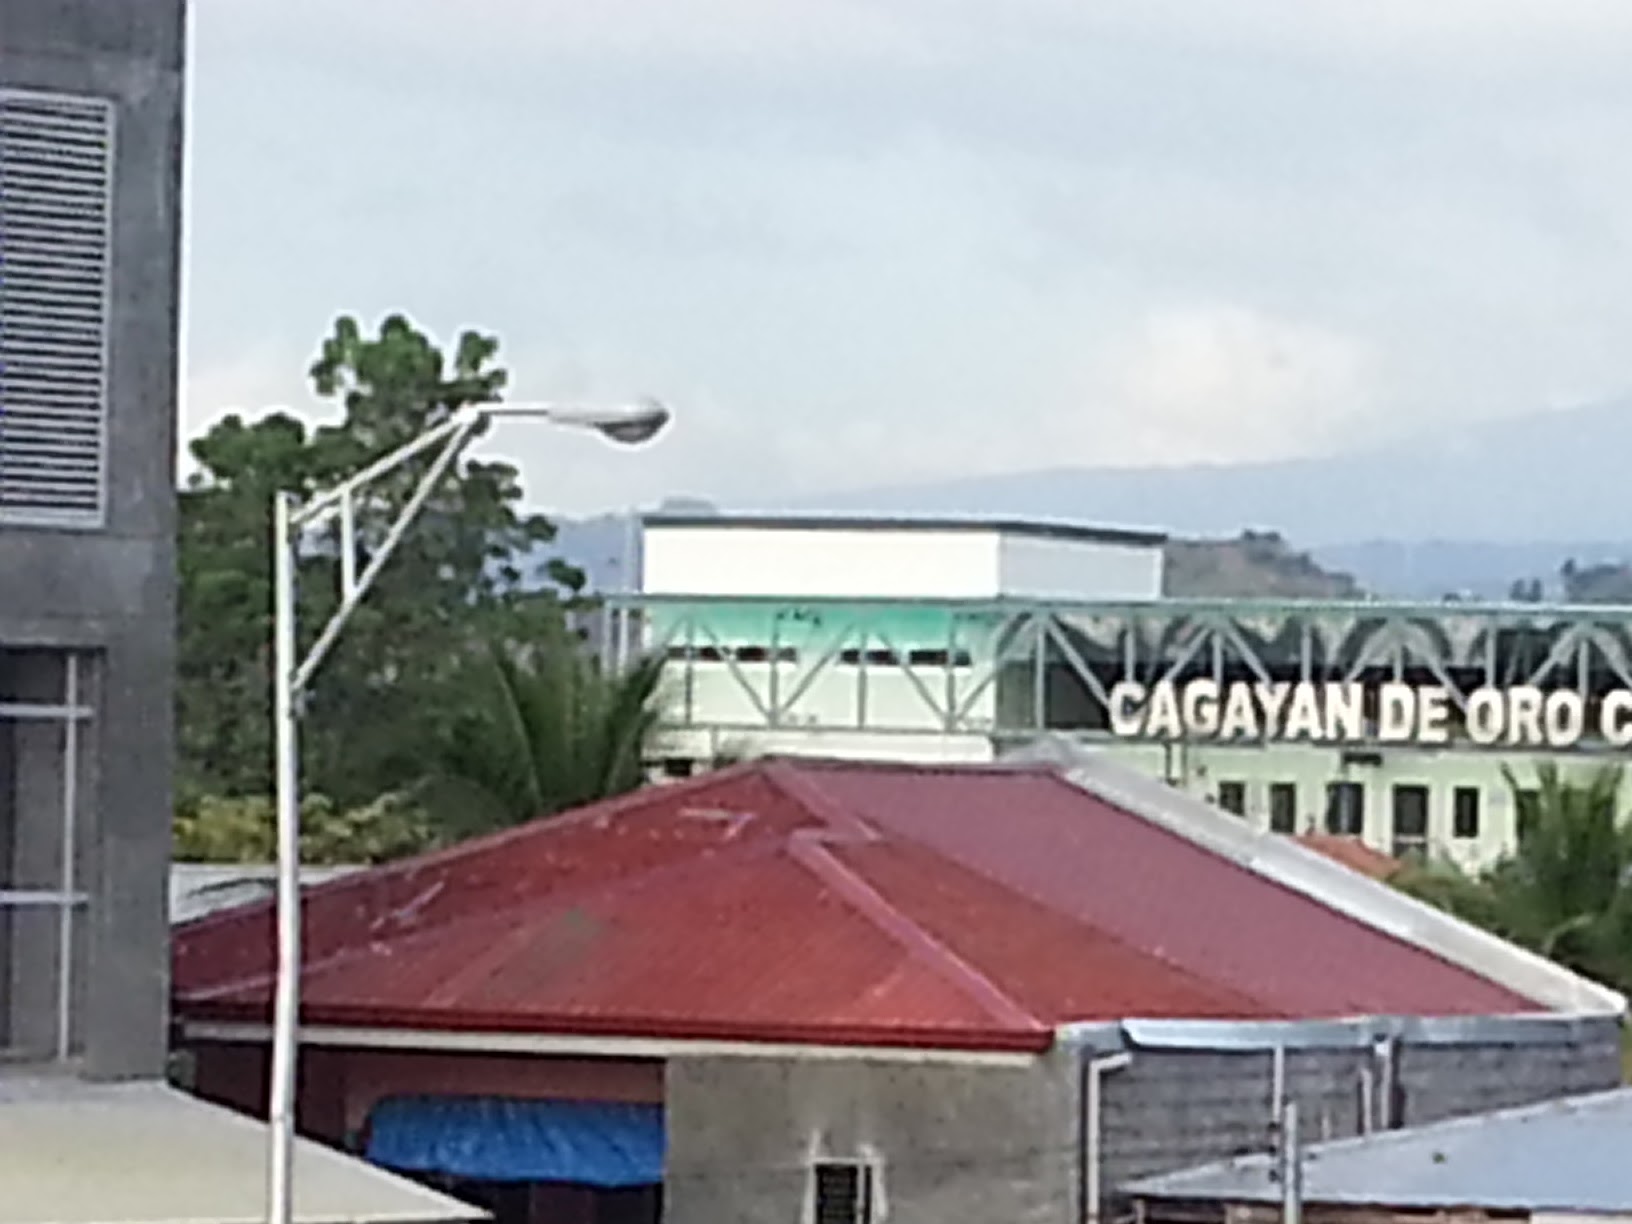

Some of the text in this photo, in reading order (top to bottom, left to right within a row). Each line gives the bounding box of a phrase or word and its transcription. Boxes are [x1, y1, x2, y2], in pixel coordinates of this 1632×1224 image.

[1108, 676, 1363, 739] CAGAYAN
[1378, 682, 1450, 743] DE
[1465, 684, 1583, 746] ORO
